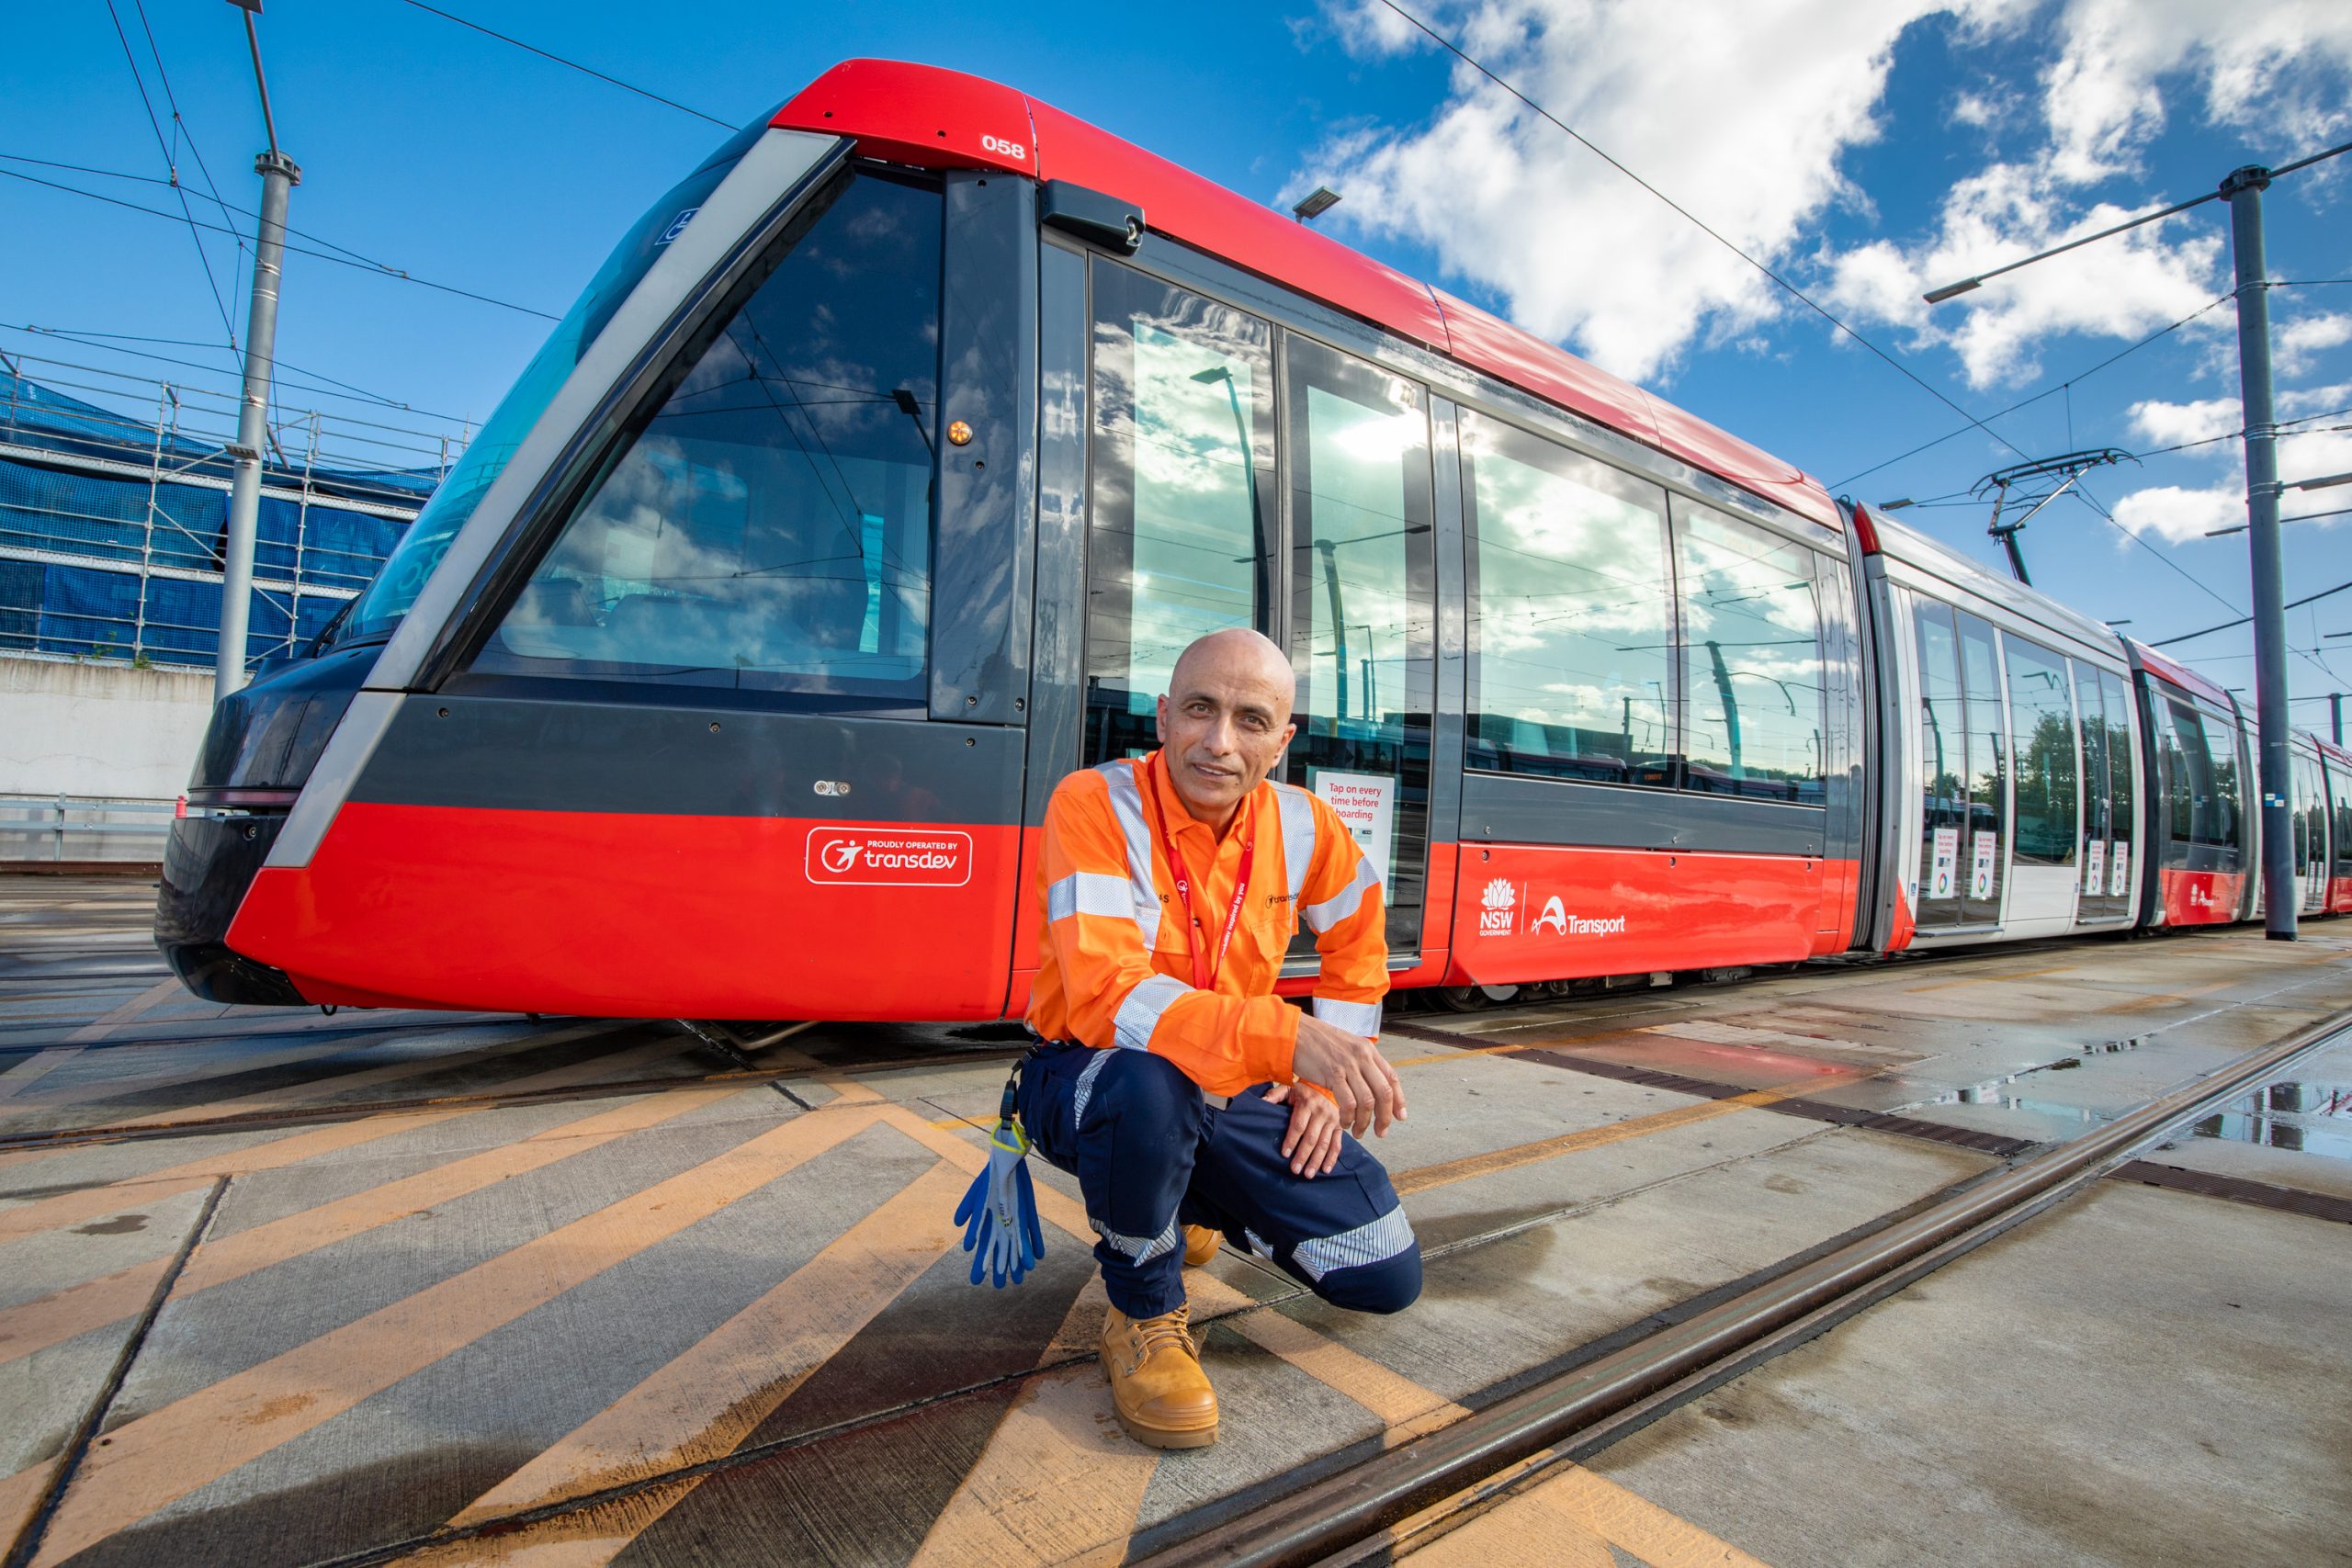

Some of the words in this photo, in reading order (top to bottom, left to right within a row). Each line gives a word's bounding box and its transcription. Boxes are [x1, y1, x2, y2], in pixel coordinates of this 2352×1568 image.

[981, 134, 1026, 160] 058
[1329, 783, 1344, 795] Tap
[1346, 785, 1357, 794] on
[1359, 787, 1382, 797] every
[1330, 795, 1351, 807] time
[1351, 796, 1379, 808] before
[1335, 807, 1374, 822] boarding
[866, 840, 905, 849] PROUDLY
[905, 841, 946, 850] OPERATED
[947, 842, 958, 851] BY
[864, 850, 957, 869] transdev
[1238, 883, 1246, 896] you
[1234, 895, 1243, 905] by
[1227, 904, 1239, 931] inspired
[1479, 910, 1514, 930] NSW
[1479, 929, 1512, 937] GOVERNMENT
[1567, 915, 1625, 937] Transport
